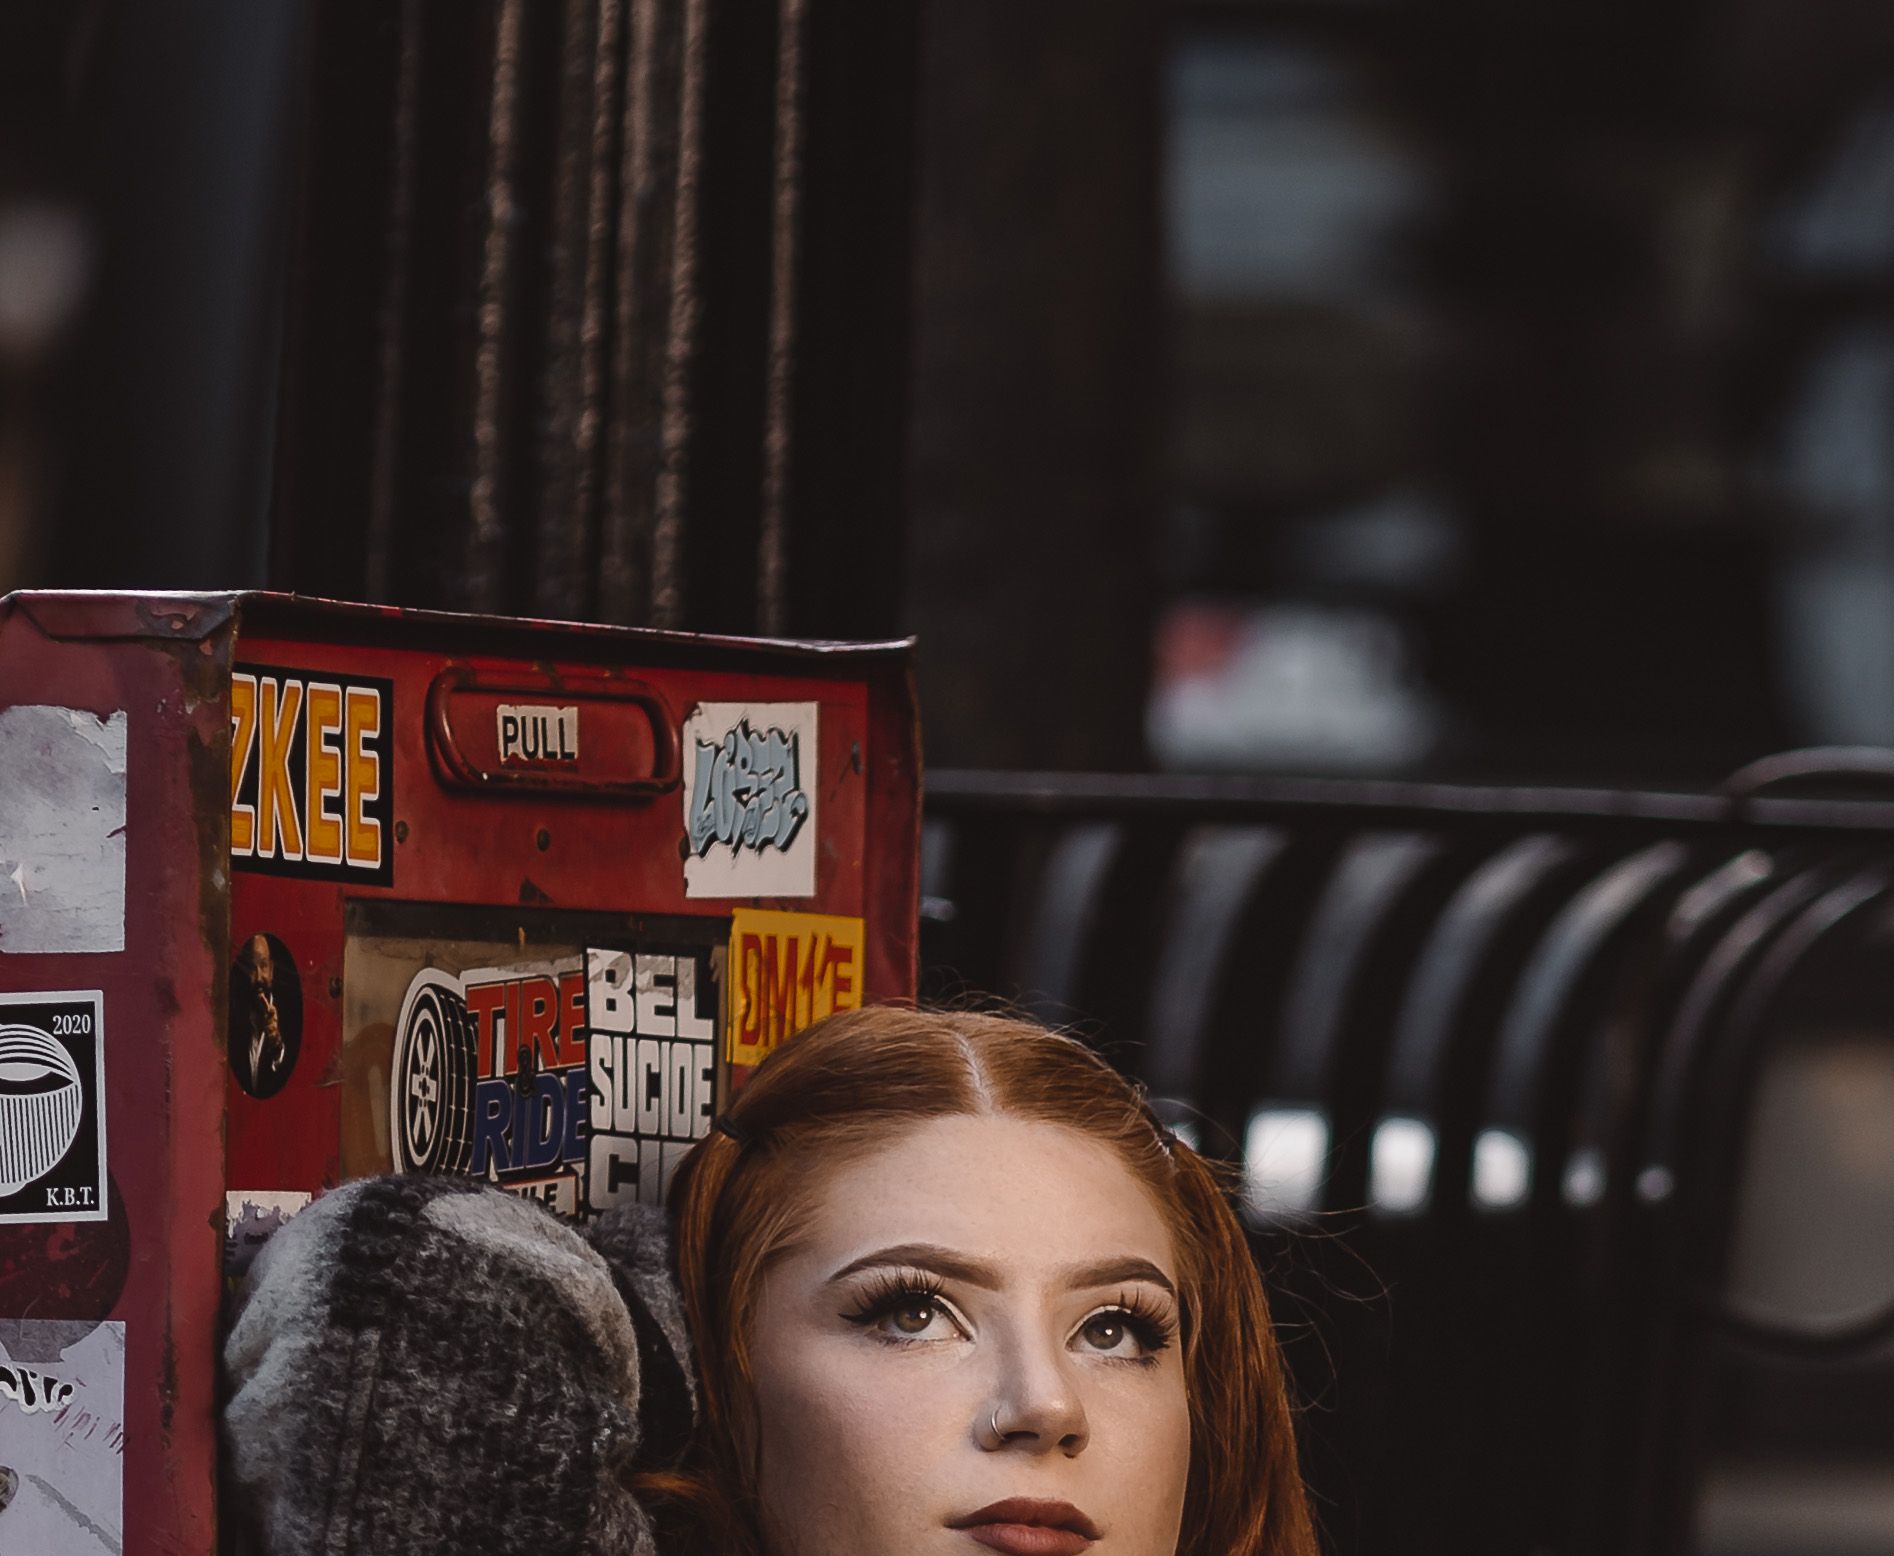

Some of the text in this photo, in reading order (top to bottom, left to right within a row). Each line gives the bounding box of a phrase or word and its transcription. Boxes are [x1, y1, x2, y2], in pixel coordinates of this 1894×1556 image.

[502, 714, 576, 760] PULL
[52, 1014, 92, 1035] 2020
[466, 970, 586, 1080] TIRE
[587, 948, 714, 1040] BEL
[471, 1066, 586, 1177] RIDE
[46, 1186, 95, 1207] K.B.T.
